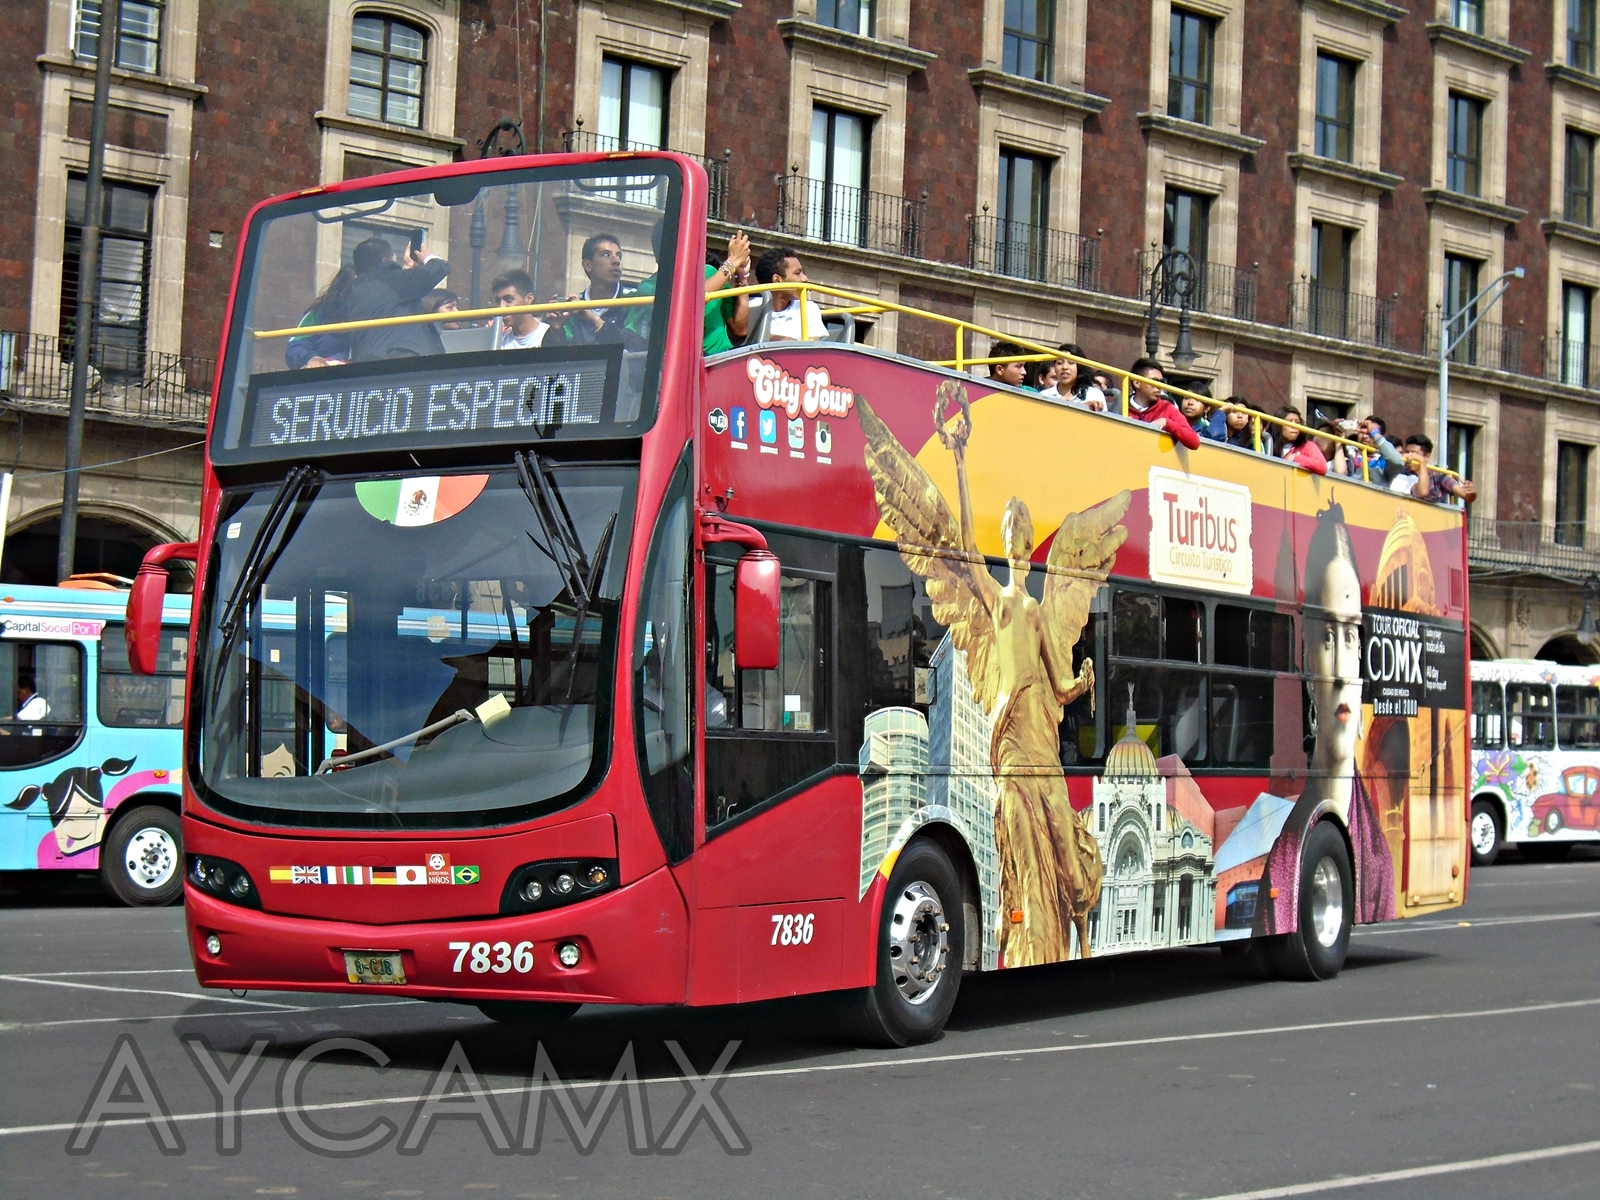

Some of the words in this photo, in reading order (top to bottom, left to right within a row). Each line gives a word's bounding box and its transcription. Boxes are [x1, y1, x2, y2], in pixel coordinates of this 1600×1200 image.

[748, 356, 801, 416] City
[803, 371, 853, 415] Tour
[269, 386, 415, 445] SERVICIO
[427, 372, 593, 433] ESPECIAL
[1163, 491, 1238, 554] Turibus
[1169, 546, 1200, 568] Circuito
[73, 623, 90, 635] Por
[1372, 614, 1392, 635] TOUR
[1392, 617, 1420, 639] OFICIAL
[1367, 636, 1423, 684] CDMX
[1374, 697, 1393, 715] Desde
[1395, 698, 1401, 715] el
[428, 875, 450, 884] NIÑOS
[770, 912, 815, 946] 7836
[448, 940, 535, 974] 7836
